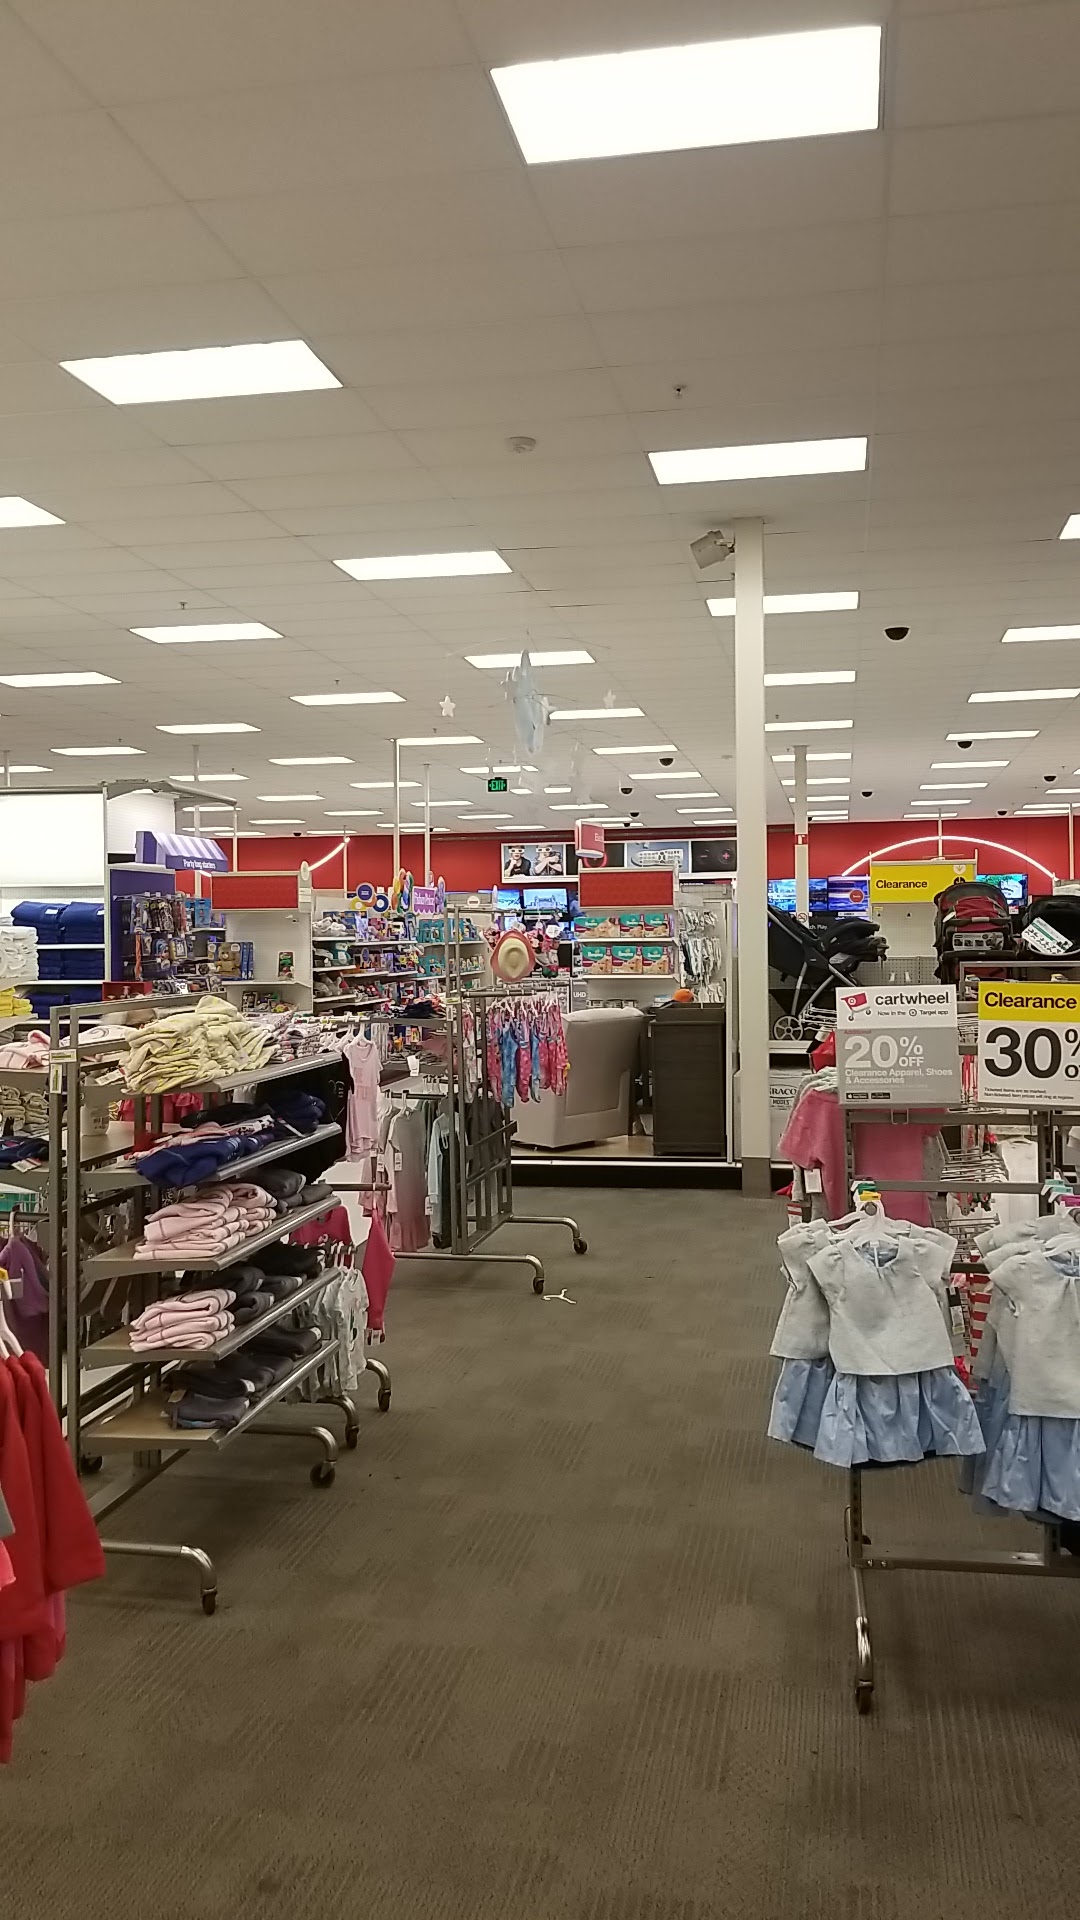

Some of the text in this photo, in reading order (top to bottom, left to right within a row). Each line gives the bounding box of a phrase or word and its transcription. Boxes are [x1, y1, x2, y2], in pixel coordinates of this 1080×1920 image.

[875, 879, 928, 890] Clearance
[875, 991, 950, 1006] cartwheel
[984, 991, 1078, 1010] Clearance
[877, 1009, 890, 1017] Now
[919, 1008, 937, 1017] Target
[937, 1009, 949, 1017] app
[898, 1056, 924, 1067] OFF
[845, 1067, 953, 1078] Clearance Apparel, Shoes
[845, 1076, 906, 1085] & Accessories
[769, 1087, 798, 1096] RACO
